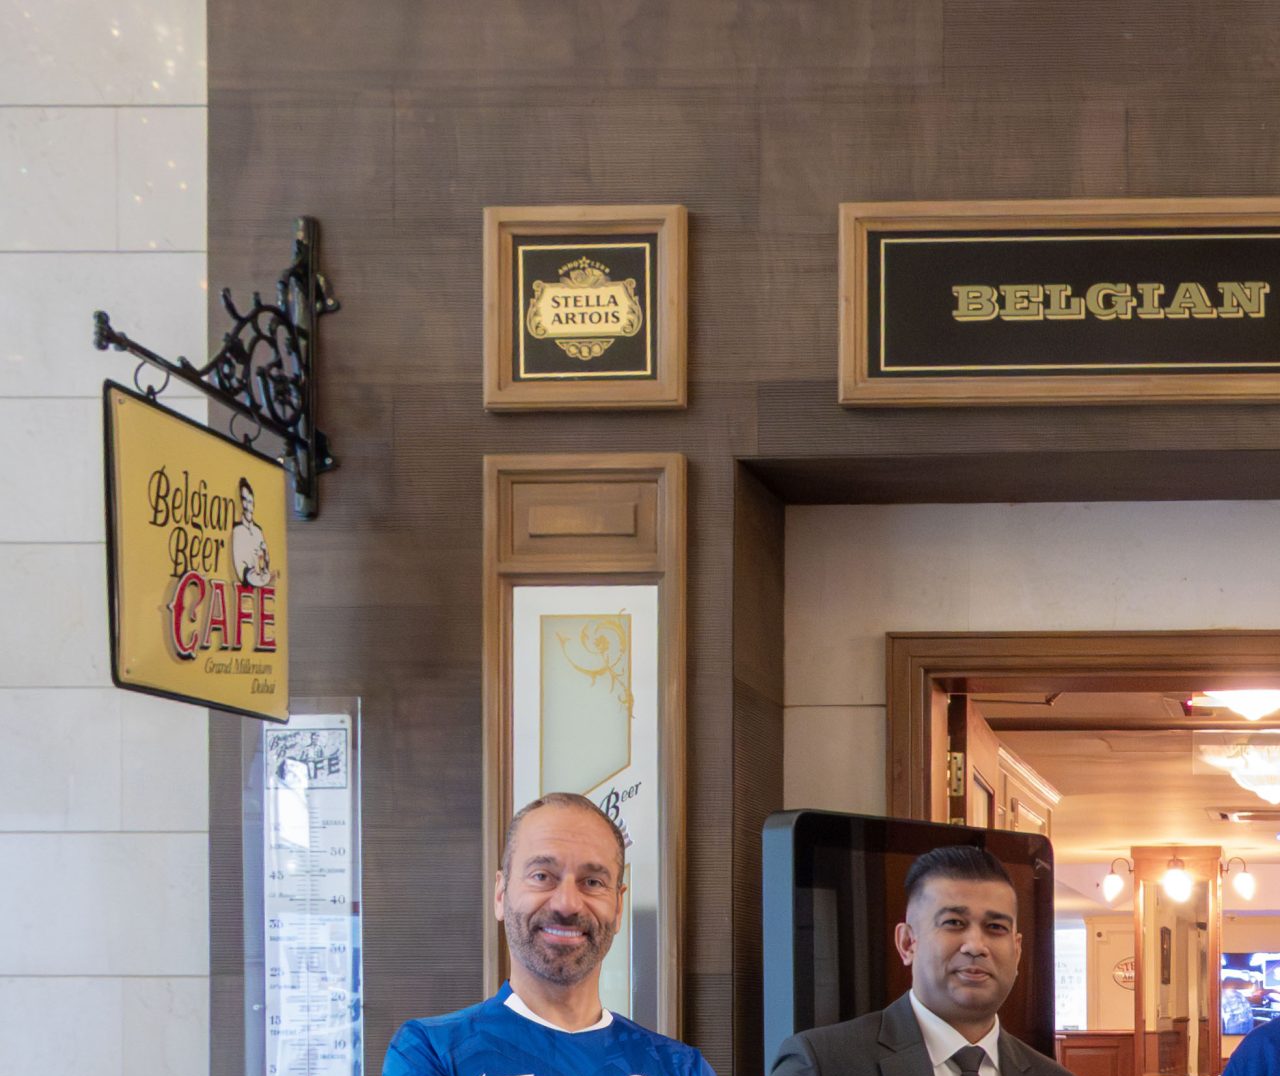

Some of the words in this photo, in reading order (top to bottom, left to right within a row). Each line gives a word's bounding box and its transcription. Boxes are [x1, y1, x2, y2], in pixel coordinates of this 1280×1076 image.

[551, 294, 619, 309] STELLA
[551, 311, 621, 325] ARTOIS
[951, 281, 1270, 322] BELGIAN
[148, 465, 236, 531] Belgian
[169, 526, 225, 578] Beer
